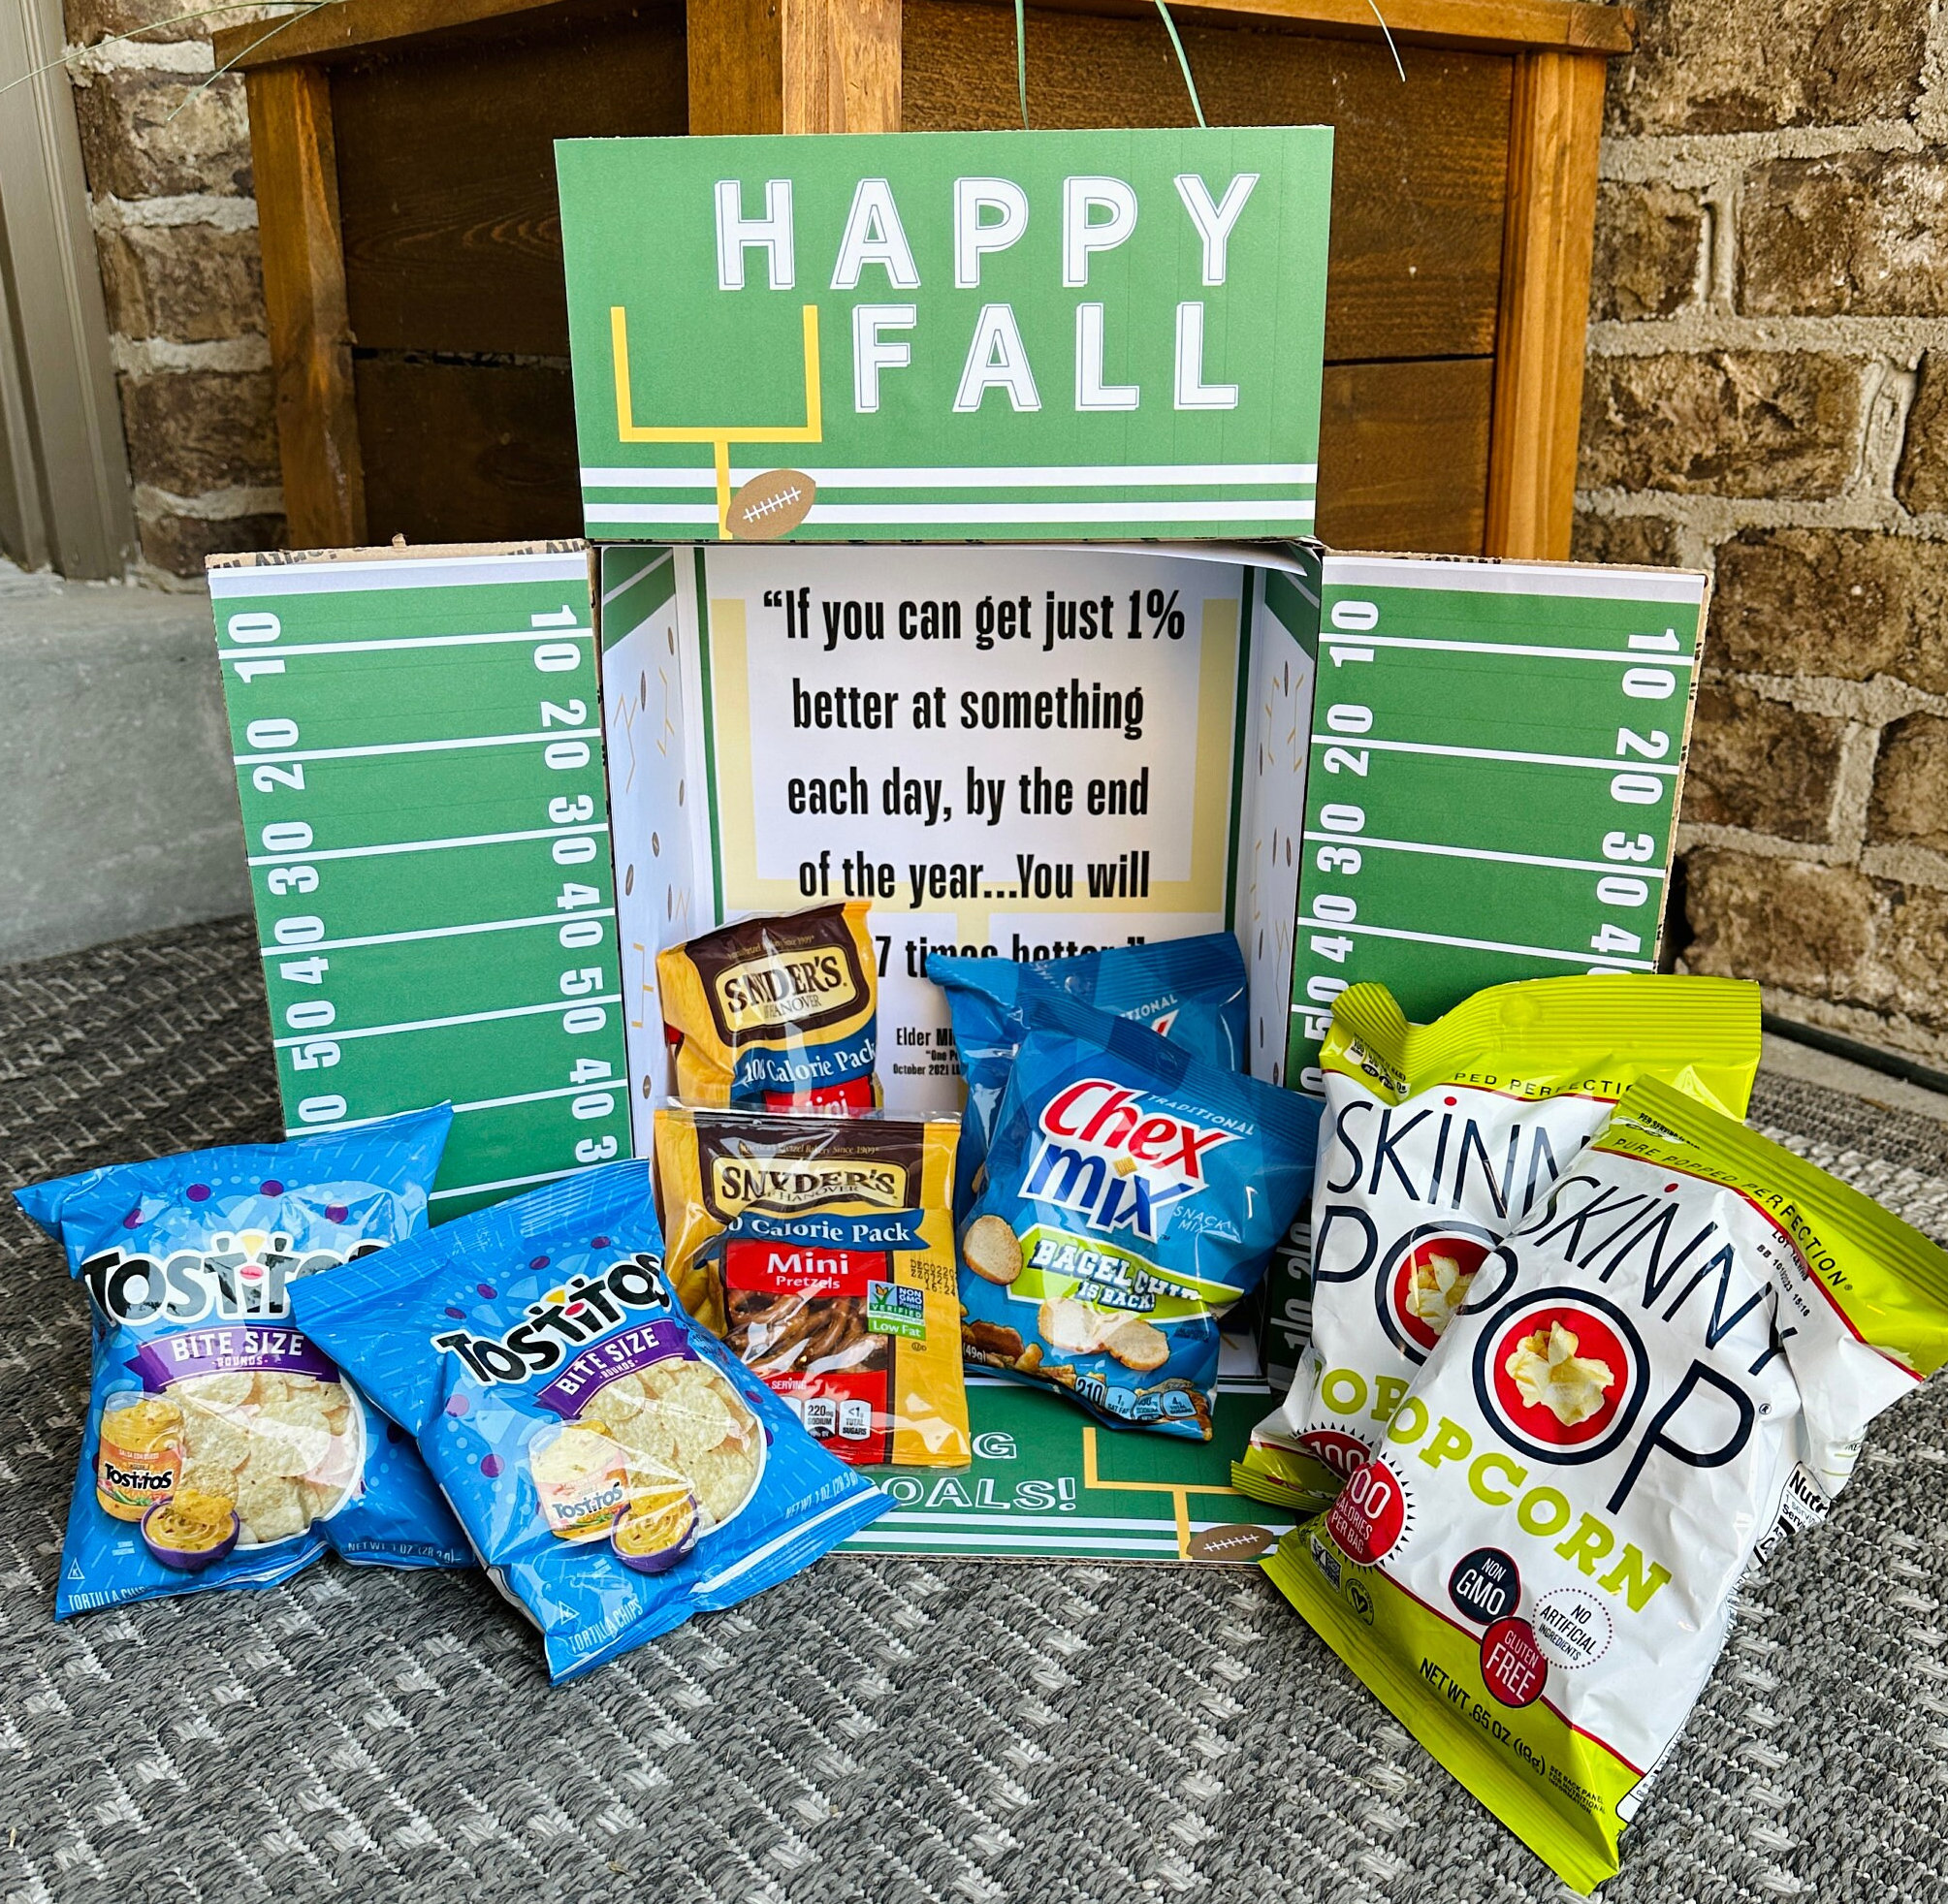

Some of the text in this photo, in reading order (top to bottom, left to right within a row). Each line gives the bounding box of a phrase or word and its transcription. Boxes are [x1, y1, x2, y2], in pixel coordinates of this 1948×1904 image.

[715, 174, 1261, 290] HAPPY
[852, 301, 1238, 413] FALL
[823, 598, 884, 651] you
[899, 597, 961, 640] can
[975, 595, 1032, 651] get
[1043, 590, 1114, 651] just
[1128, 589, 1185, 640] 1%
[792, 678, 1144, 740] better at something
[788, 766, 1149, 826] each day, by the end
[799, 851, 831, 898] of
[842, 851, 896, 899] the
[1088, 850, 1149, 898] will
[875, 936, 891, 977] 7
[1121, 994, 1179, 1020] TIONAL
[897, 1027, 931, 1046] Elder
[767, 1055, 835, 1083] Calorie
[834, 1038, 876, 1072] Pack
[893, 1063, 925, 1075] October
[929, 1063, 948, 1075] 2021
[1044, 1081, 1228, 1179] Chex
[1147, 1094, 1256, 1136] TRADITIONAL
[779, 1143, 805, 1154] Pretzel
[833, 1145, 854, 1155] Since
[721, 1166, 894, 1201] SNYDER'S
[780, 1187, 859, 1202] HANOVER
[1027, 1143, 1195, 1236] mix
[1614, 1137, 1660, 1158] PURE
[1663, 1156, 1739, 1182] POPPED
[1742, 1182, 1848, 1288] PERFECTION
[751, 1220, 911, 1243] Calorie Pack
[1772, 1229, 1790, 1249] LOT
[767, 1252, 849, 1275] Mini
[1032, 1240, 1133, 1287] BAGEL
[1757, 1244, 1772, 1258] BB
[776, 1276, 841, 1289] Pretzels
[910, 1259, 956, 1277] DEC0220
[1511, 1176, 1798, 1376] SKINNY
[899, 1288, 922, 1298] NON
[899, 1295, 922, 1304] GMO
[1077, 1282, 1156, 1310] IS BACK!
[873, 1305, 922, 1318] VERIFIED
[874, 1320, 921, 1337] Low Fat
[171, 1331, 304, 1362] BITE SIZE
[216, 1355, 265, 1368] ROUNDS
[556, 1327, 659, 1396] BITE SIZE
[963, 1342, 986, 1364] (49g)
[601, 1359, 636, 1380] ROUNDS
[772, 1380, 807, 1390] SERVING
[1077, 1379, 1102, 1407] 210
[808, 1417, 832, 1426] SODIUM
[843, 1427, 867, 1436] SUGARS
[864, 1476, 1076, 1511] OALS!
[1346, 1468, 1391, 1519] 100
[1387, 1396, 1673, 1613] OPCORN
[784, 1501, 801, 1520] NET
[1335, 1490, 1373, 1540] CALORIES
[348, 1541, 367, 1551] NET
[1331, 1511, 1364, 1555] PER BAG
[1482, 1557, 1507, 1582] NON
[1456, 1569, 1506, 1616] GMO
[568, 1593, 644, 1654] TORTILLA CHIPS
[1570, 1603, 1592, 1625] NO
[1538, 1623, 1581, 1661] INGREDIENTS
[1539, 1604, 1597, 1656] ARTIFICIAL
[1504, 1630, 1540, 1669] GLUTEN
[1485, 1642, 1536, 1702] FREE
[1420, 1657, 1450, 1691] NET
[1468, 1703, 1490, 1730] .65
[1491, 1720, 1513, 1746] OZ
[1514, 1737, 1547, 1777] (18g)
[1563, 1775, 1581, 1793] BACK
[1581, 1789, 1604, 1804] PANEL
